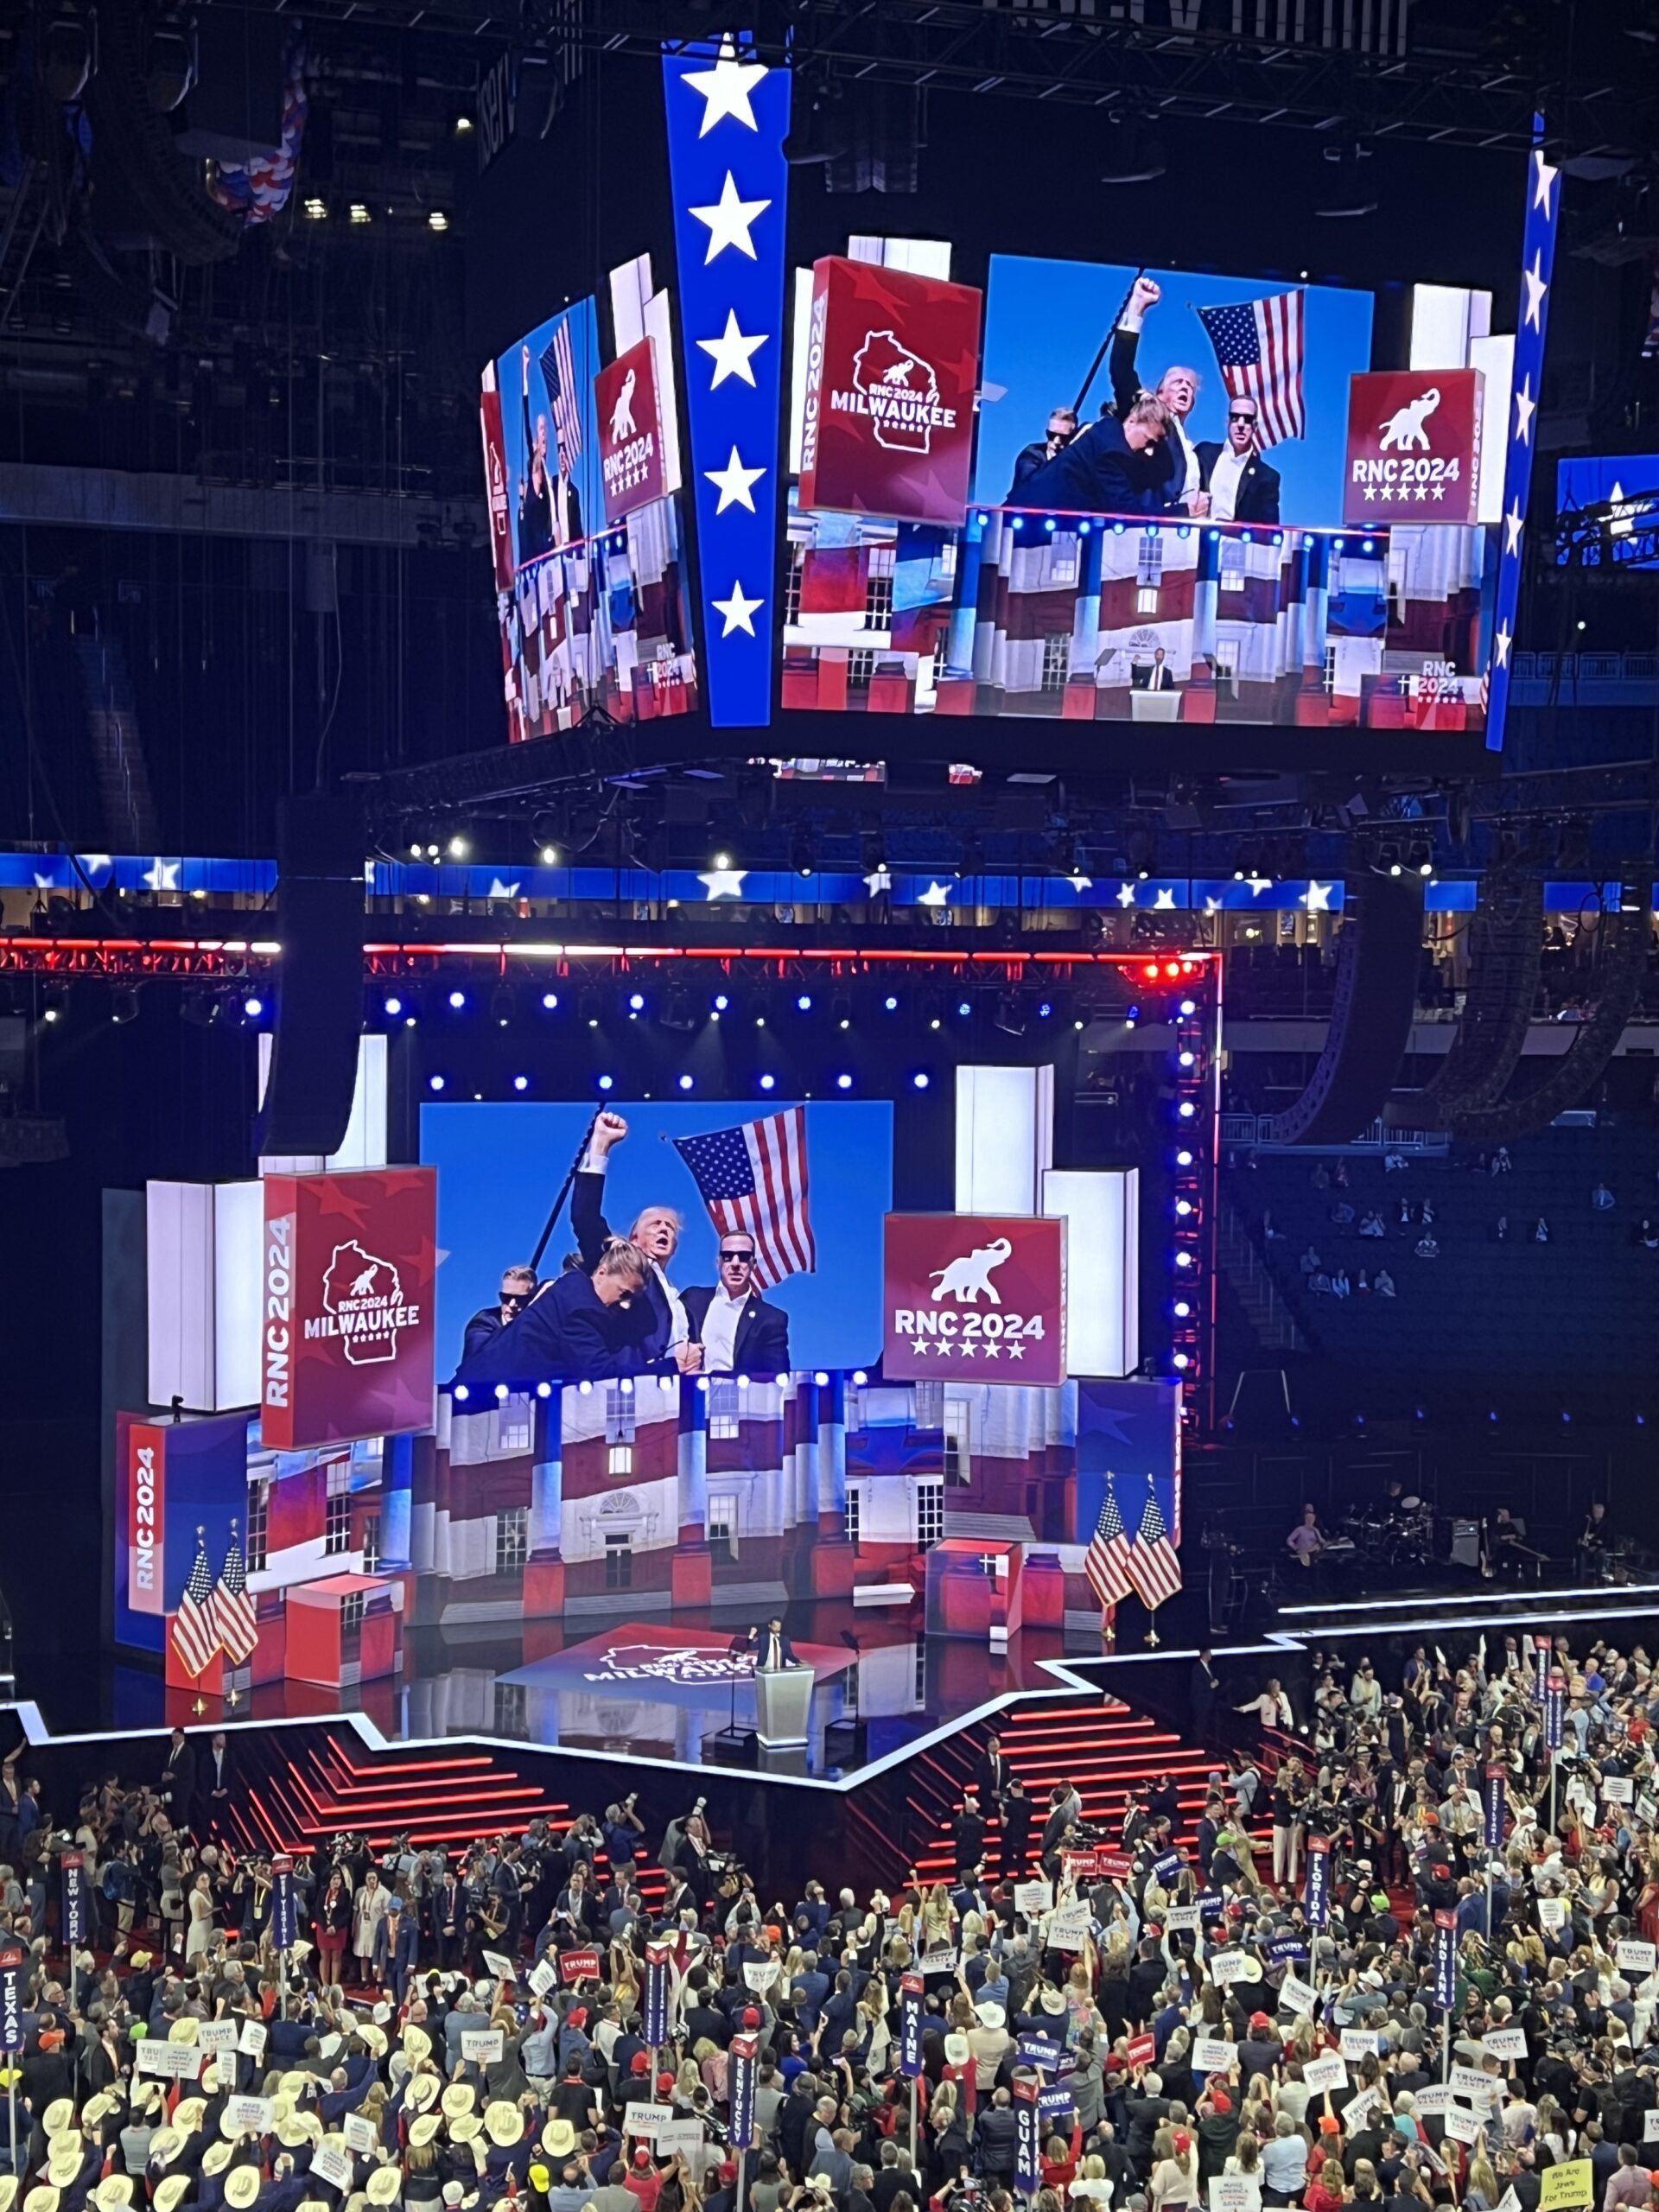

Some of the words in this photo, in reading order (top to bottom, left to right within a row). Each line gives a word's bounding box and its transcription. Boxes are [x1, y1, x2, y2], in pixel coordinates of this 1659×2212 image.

[830, 389, 957, 429] MILWAUKEE
[1422, 660, 1456, 677] RNC
[1418, 677, 1459, 694] 2024
[304, 1305, 420, 1339] MILWAUKEE
[67, 1868, 79, 1897] NEW
[1309, 1853, 1323, 1922] FLORIDA
[68, 1900, 79, 1939] YORK
[1271, 1942, 1303, 1954] TRUMP
[563, 1959, 596, 1971] TRUMP
[1438, 1929, 1447, 2004] INDIANA
[3, 1971, 18, 2044] TEXAS
[466, 2038, 499, 2048] TRUMP
[906, 2000, 918, 2064] MAINE
[1023, 2042, 1058, 2056] TRUMP
[1456, 2073, 1492, 2083] TRUMP
[631, 2112, 667, 2122] TRUMP
[1017, 2109, 1031, 2177] GUAM
[1560, 2190, 1587, 2199] Trump
